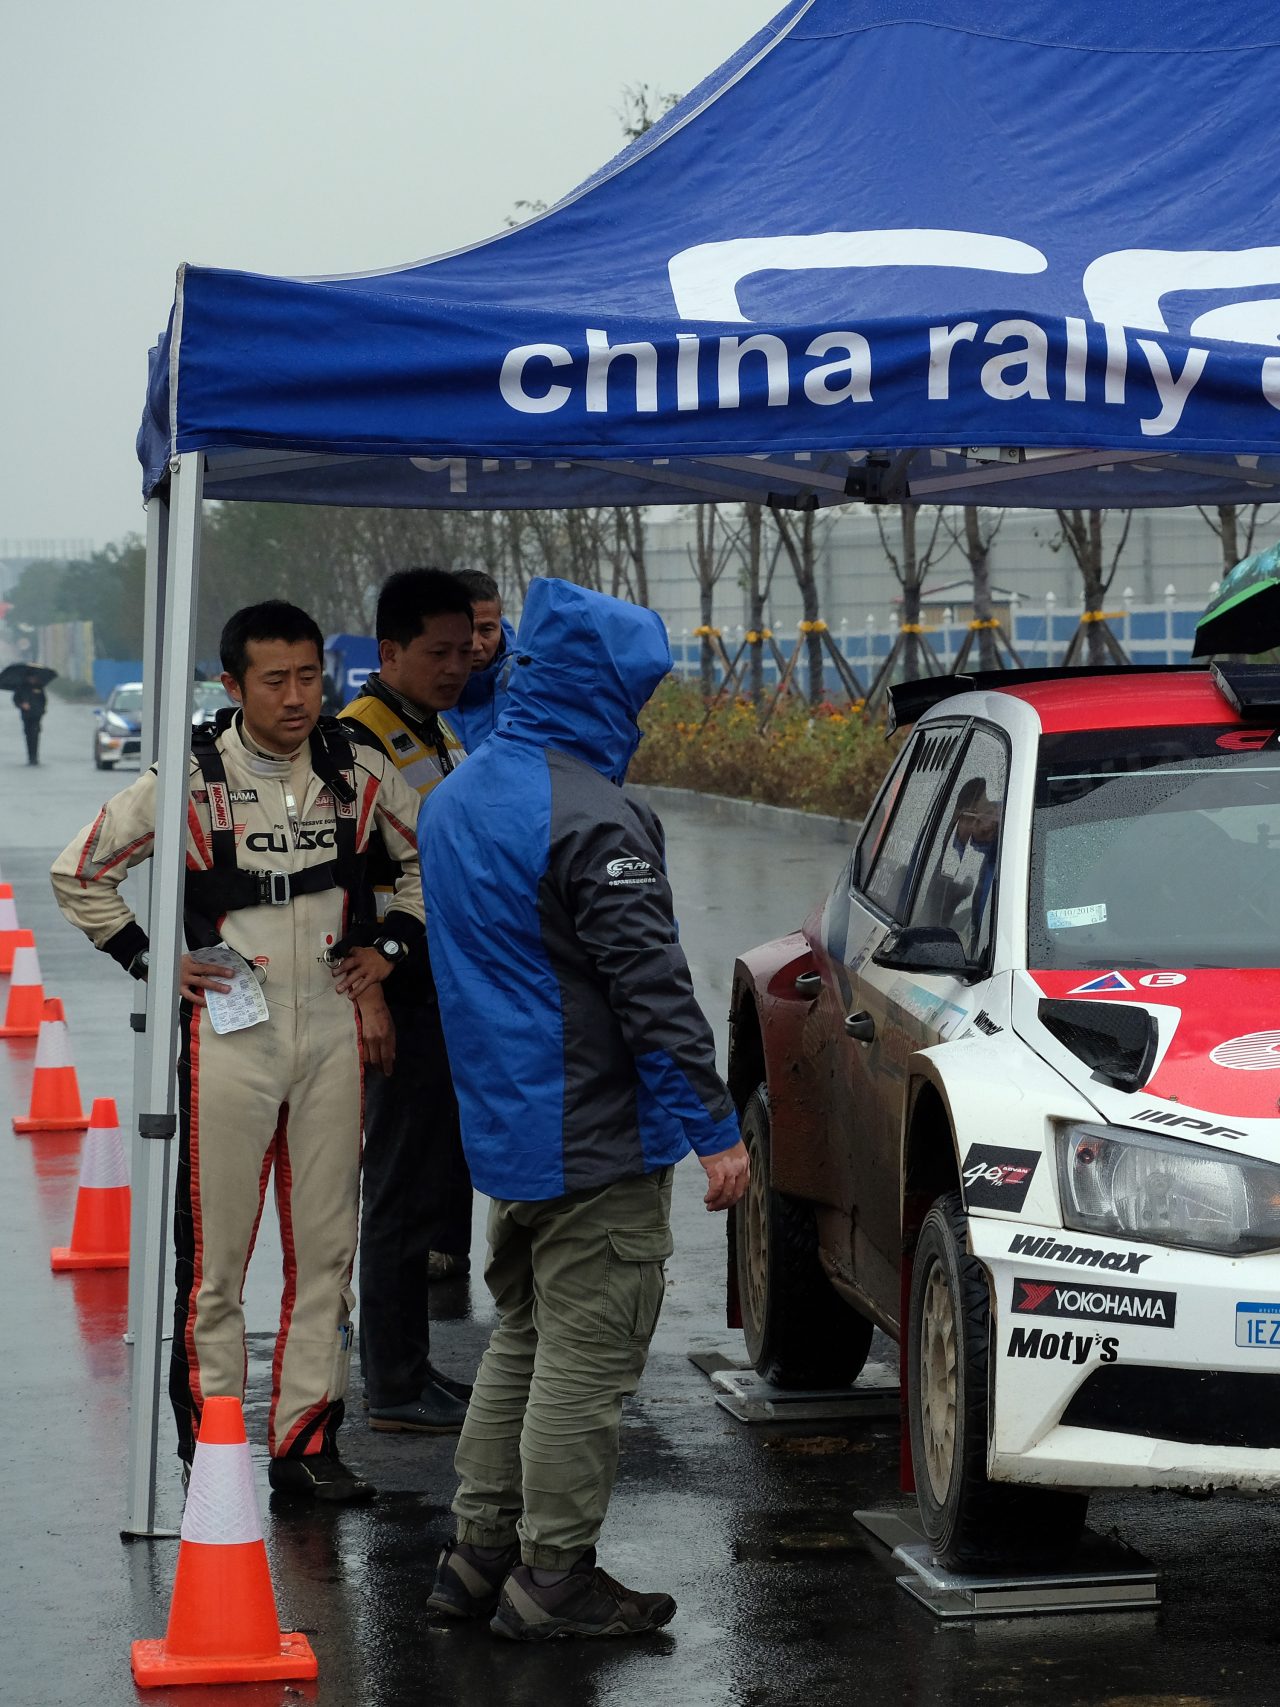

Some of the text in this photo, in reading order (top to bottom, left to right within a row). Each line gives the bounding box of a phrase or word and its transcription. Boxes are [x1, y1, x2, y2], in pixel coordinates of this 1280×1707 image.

[499, 329, 873, 414] china
[927, 316, 1209, 436] rally
[212, 786, 227, 827] SIMPSON
[230, 792, 256, 801] HAMA
[246, 828, 337, 852] CUSC
[1054, 1289, 1167, 1320] YOKOHAMA
[1007, 1327, 1120, 1365] Moty's
